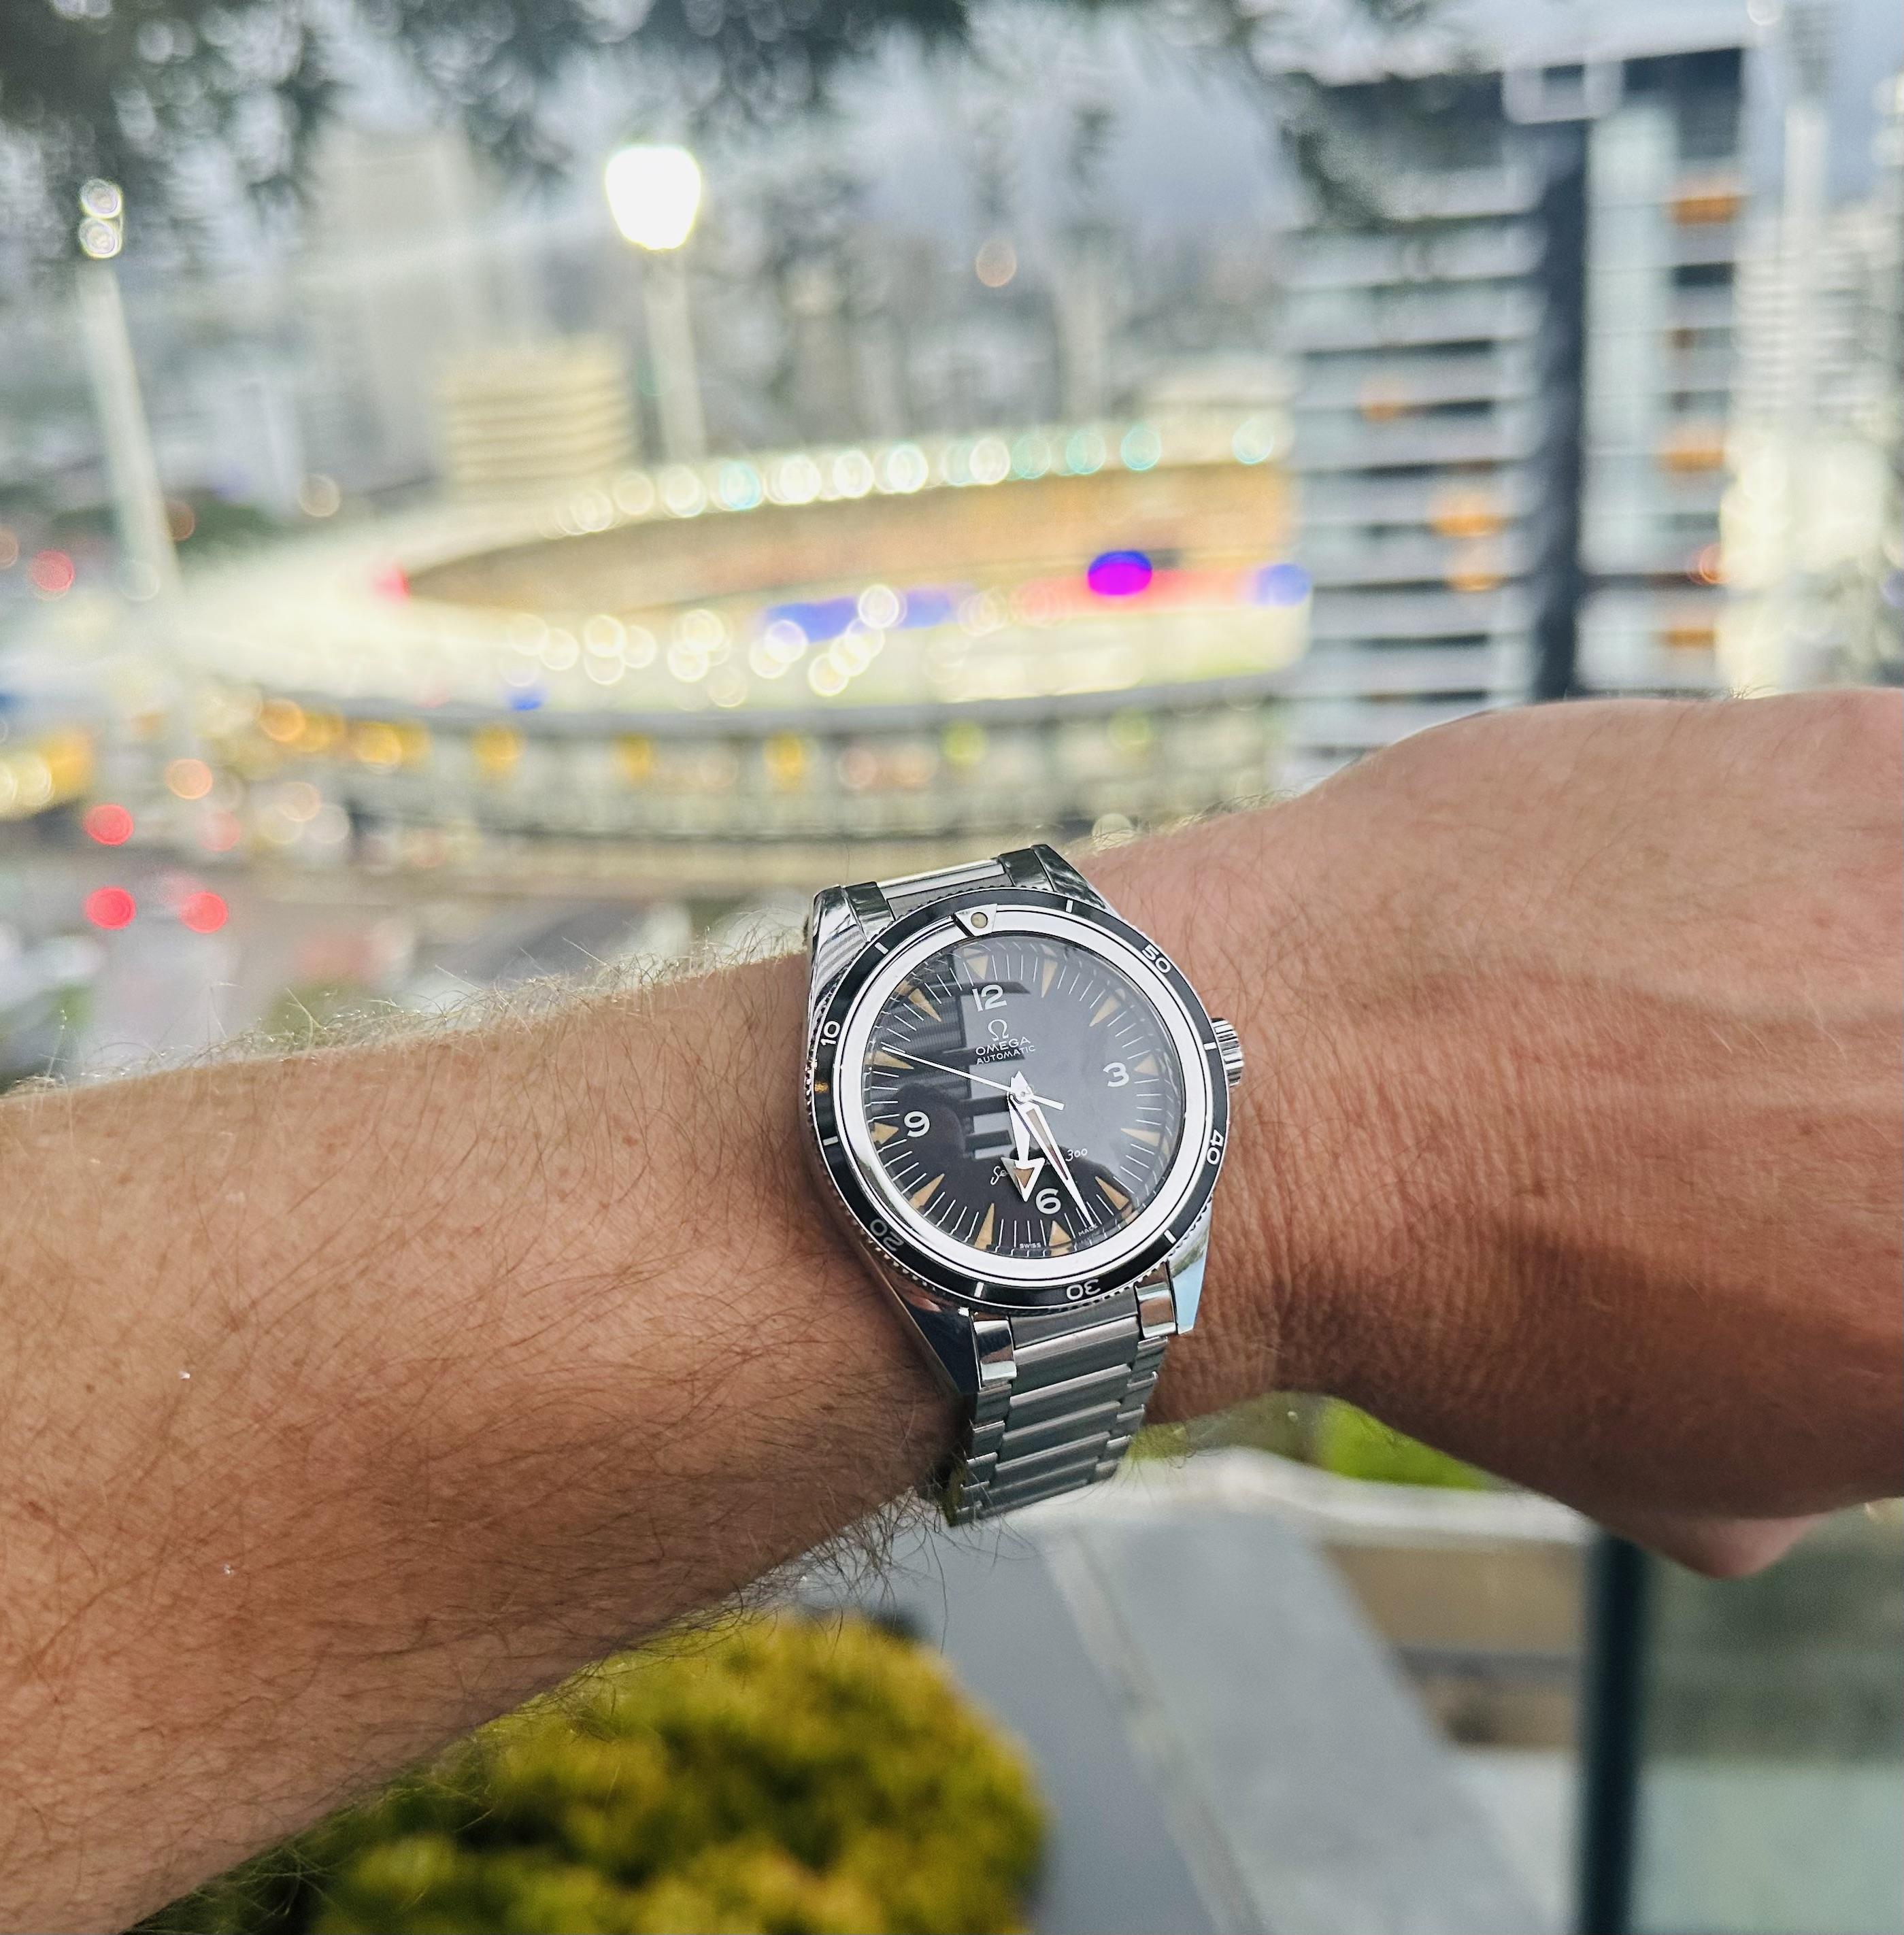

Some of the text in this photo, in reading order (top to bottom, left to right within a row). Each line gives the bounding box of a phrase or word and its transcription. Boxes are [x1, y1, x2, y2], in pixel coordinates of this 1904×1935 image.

[1142, 945, 1171, 973] 50
[972, 984, 1007, 1012] 12
[820, 1020, 841, 1046] 10
[975, 1036, 1031, 1056] OMEGA
[976, 1045, 1036, 1065] AUTOMATIC
[1103, 1062, 1129, 1087] 3
[904, 1111, 931, 1138] 9
[1065, 1148, 1088, 1162] 300
[1206, 1129, 1224, 1165] 40
[1035, 1188, 1061, 1214] 6
[869, 1218, 904, 1251] 20
[1066, 1279, 1101, 1300] 30
